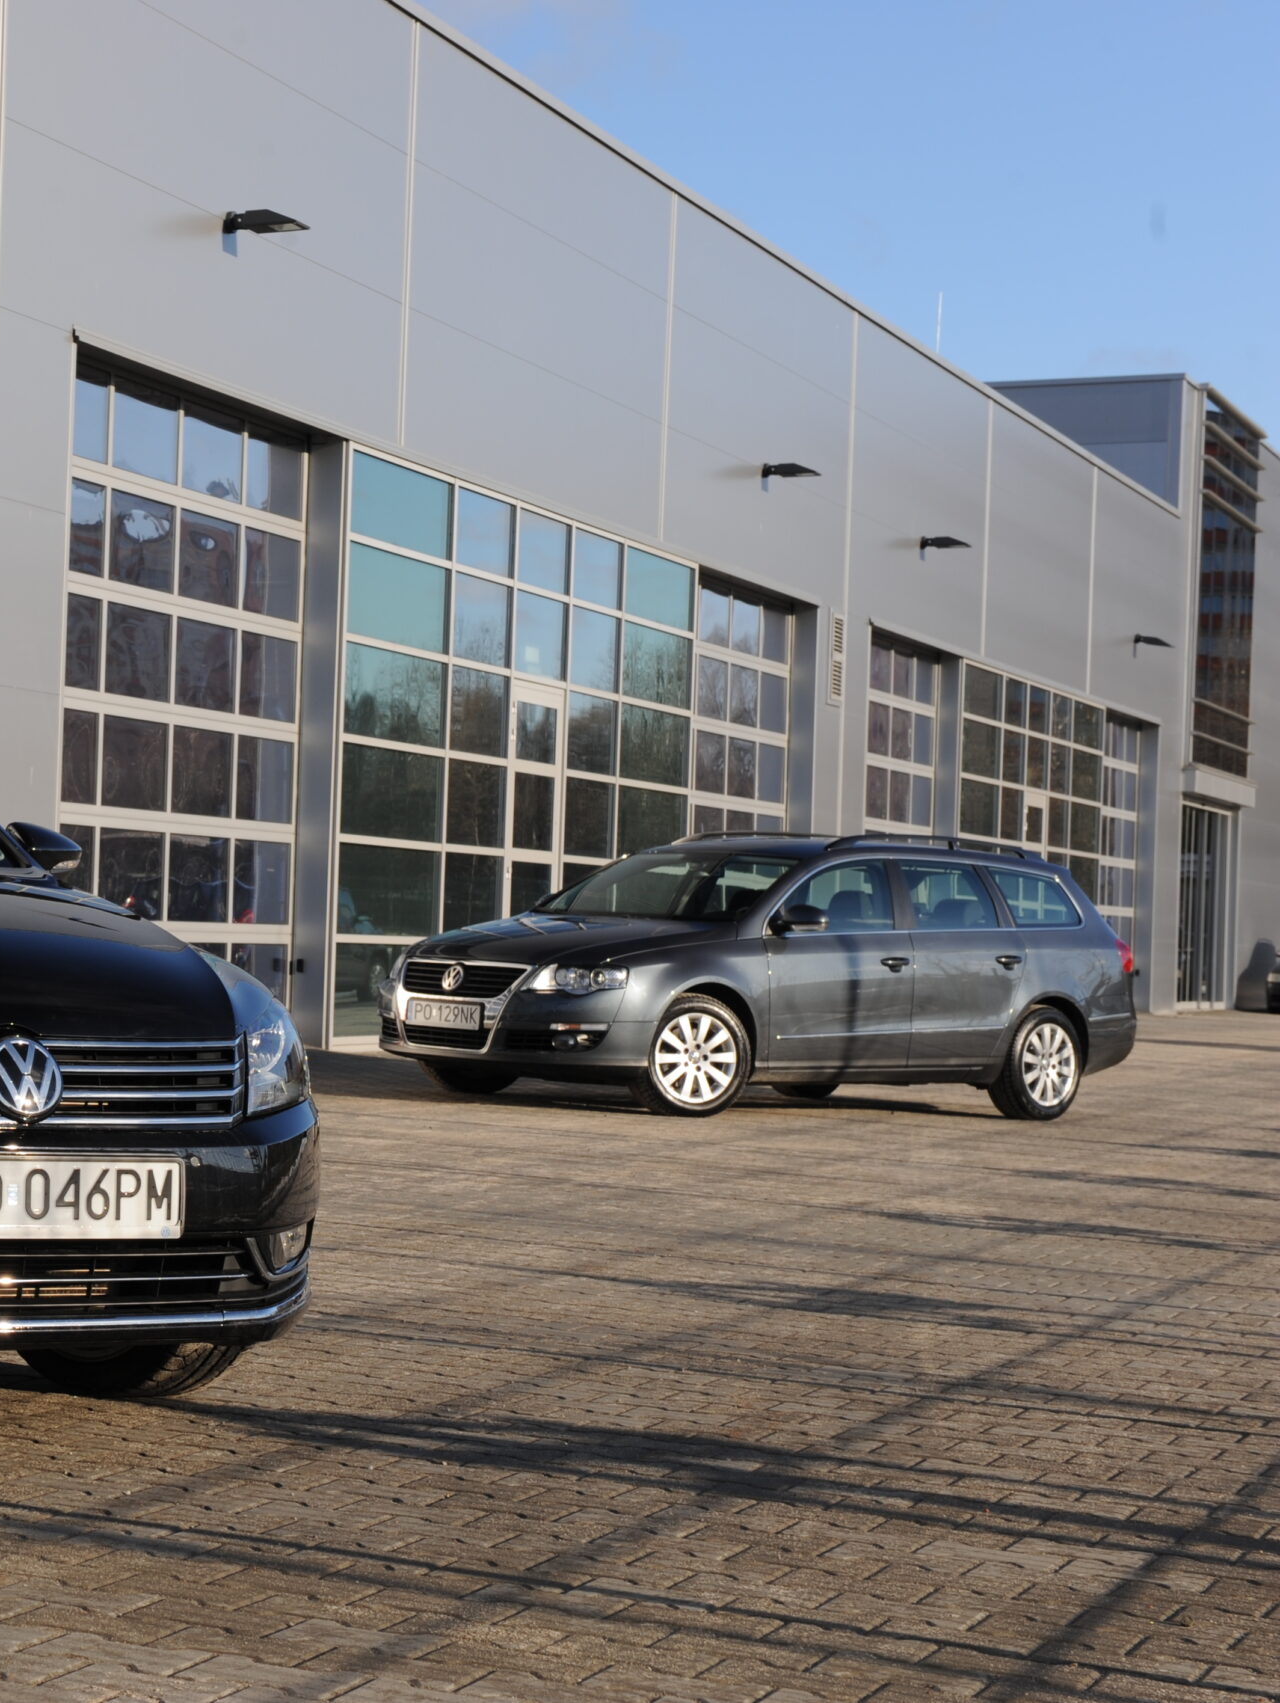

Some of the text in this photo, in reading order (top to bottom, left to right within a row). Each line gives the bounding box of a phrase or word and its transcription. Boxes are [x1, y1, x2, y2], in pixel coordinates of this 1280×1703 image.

[442, 966, 463, 990] VW
[414, 1002, 478, 1025] PO 129NK
[25, 1168, 173, 1221] 046PM
